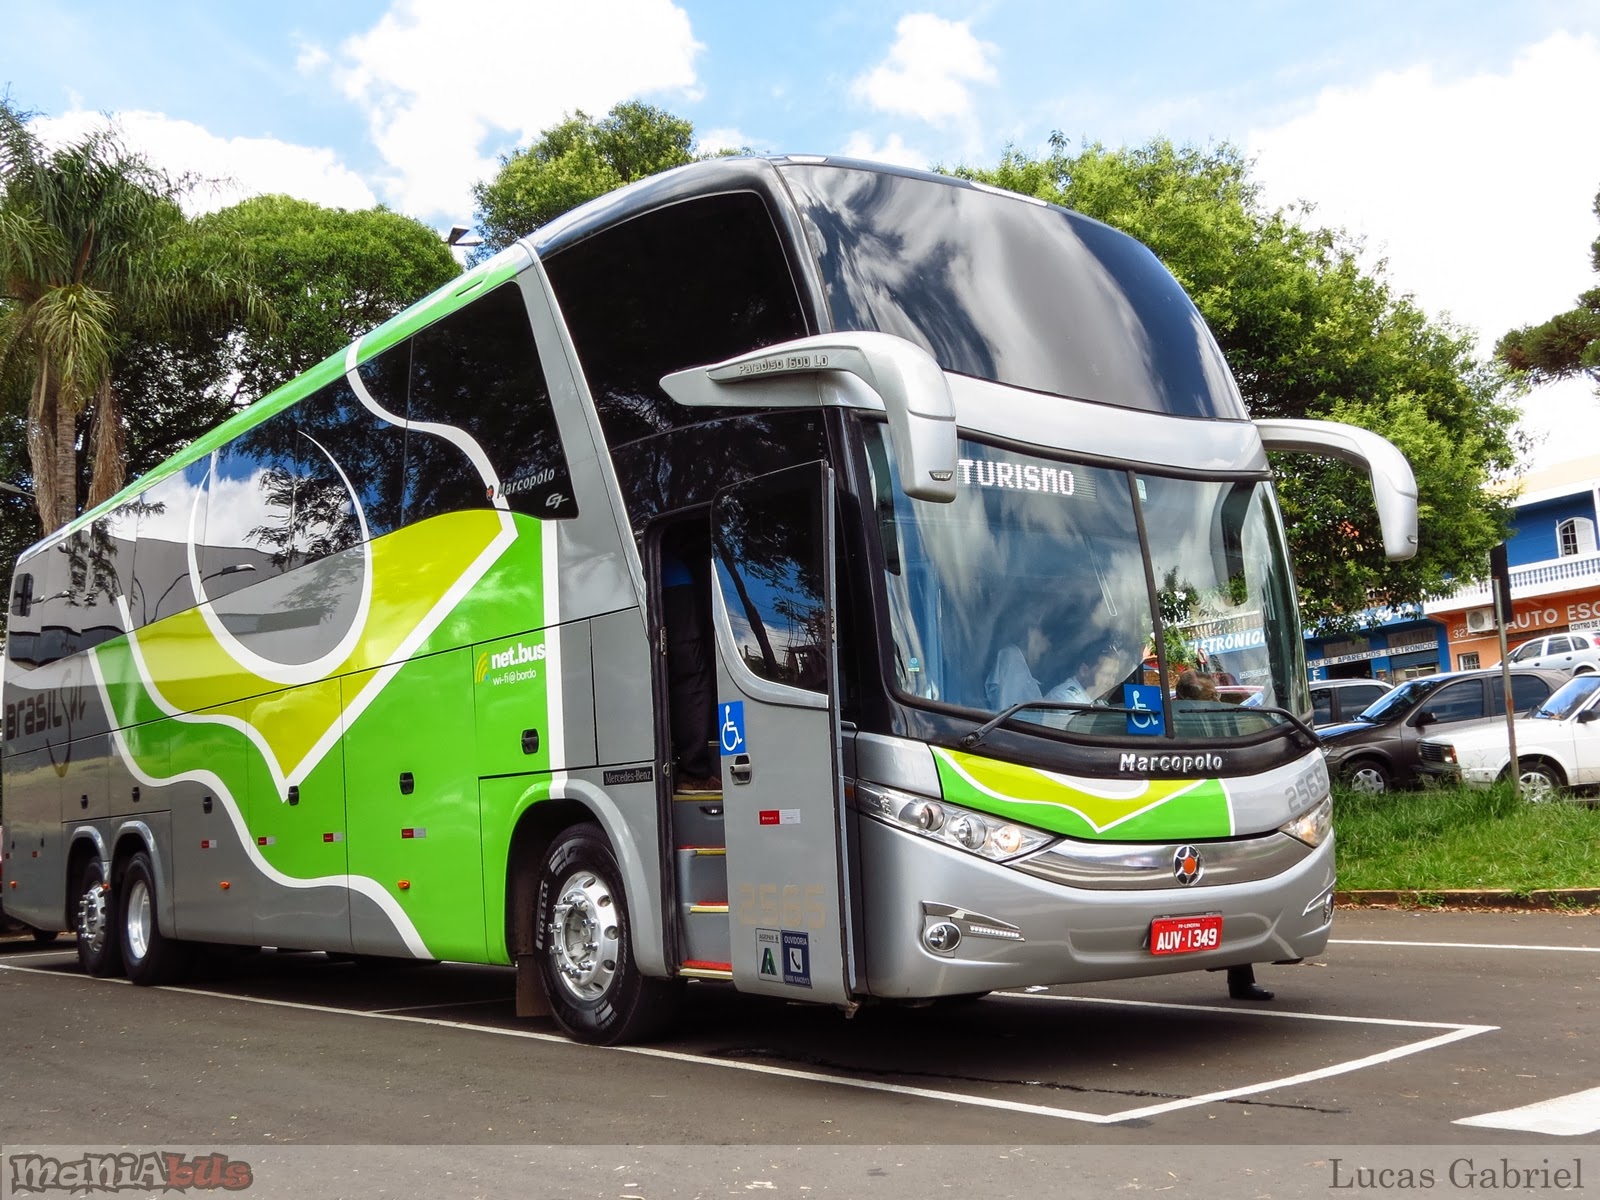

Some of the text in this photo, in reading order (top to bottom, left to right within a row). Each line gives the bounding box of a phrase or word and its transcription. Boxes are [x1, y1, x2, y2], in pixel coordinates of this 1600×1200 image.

[738, 358, 784, 376] Paradiso
[786, 356, 811, 369] 1600
[497, 468, 555, 499] Marcopolo
[958, 459, 1075, 496] TURISMO
[1505, 608, 1558, 631] AUTO
[1571, 621, 1590, 631] CENTRO
[491, 642, 546, 670] net.bus
[1323, 658, 1333, 666] DE
[1337, 650, 1381, 663] APARELHOS
[492, 668, 537, 686] wi-fi@bordo
[1119, 752, 1223, 773] Marcopolo
[605, 768, 651, 783] Mercedes-Benz
[1284, 767, 1328, 813] 2565
[739, 883, 827, 930] 2565
[784, 935, 807, 946] OUVIDORIA
